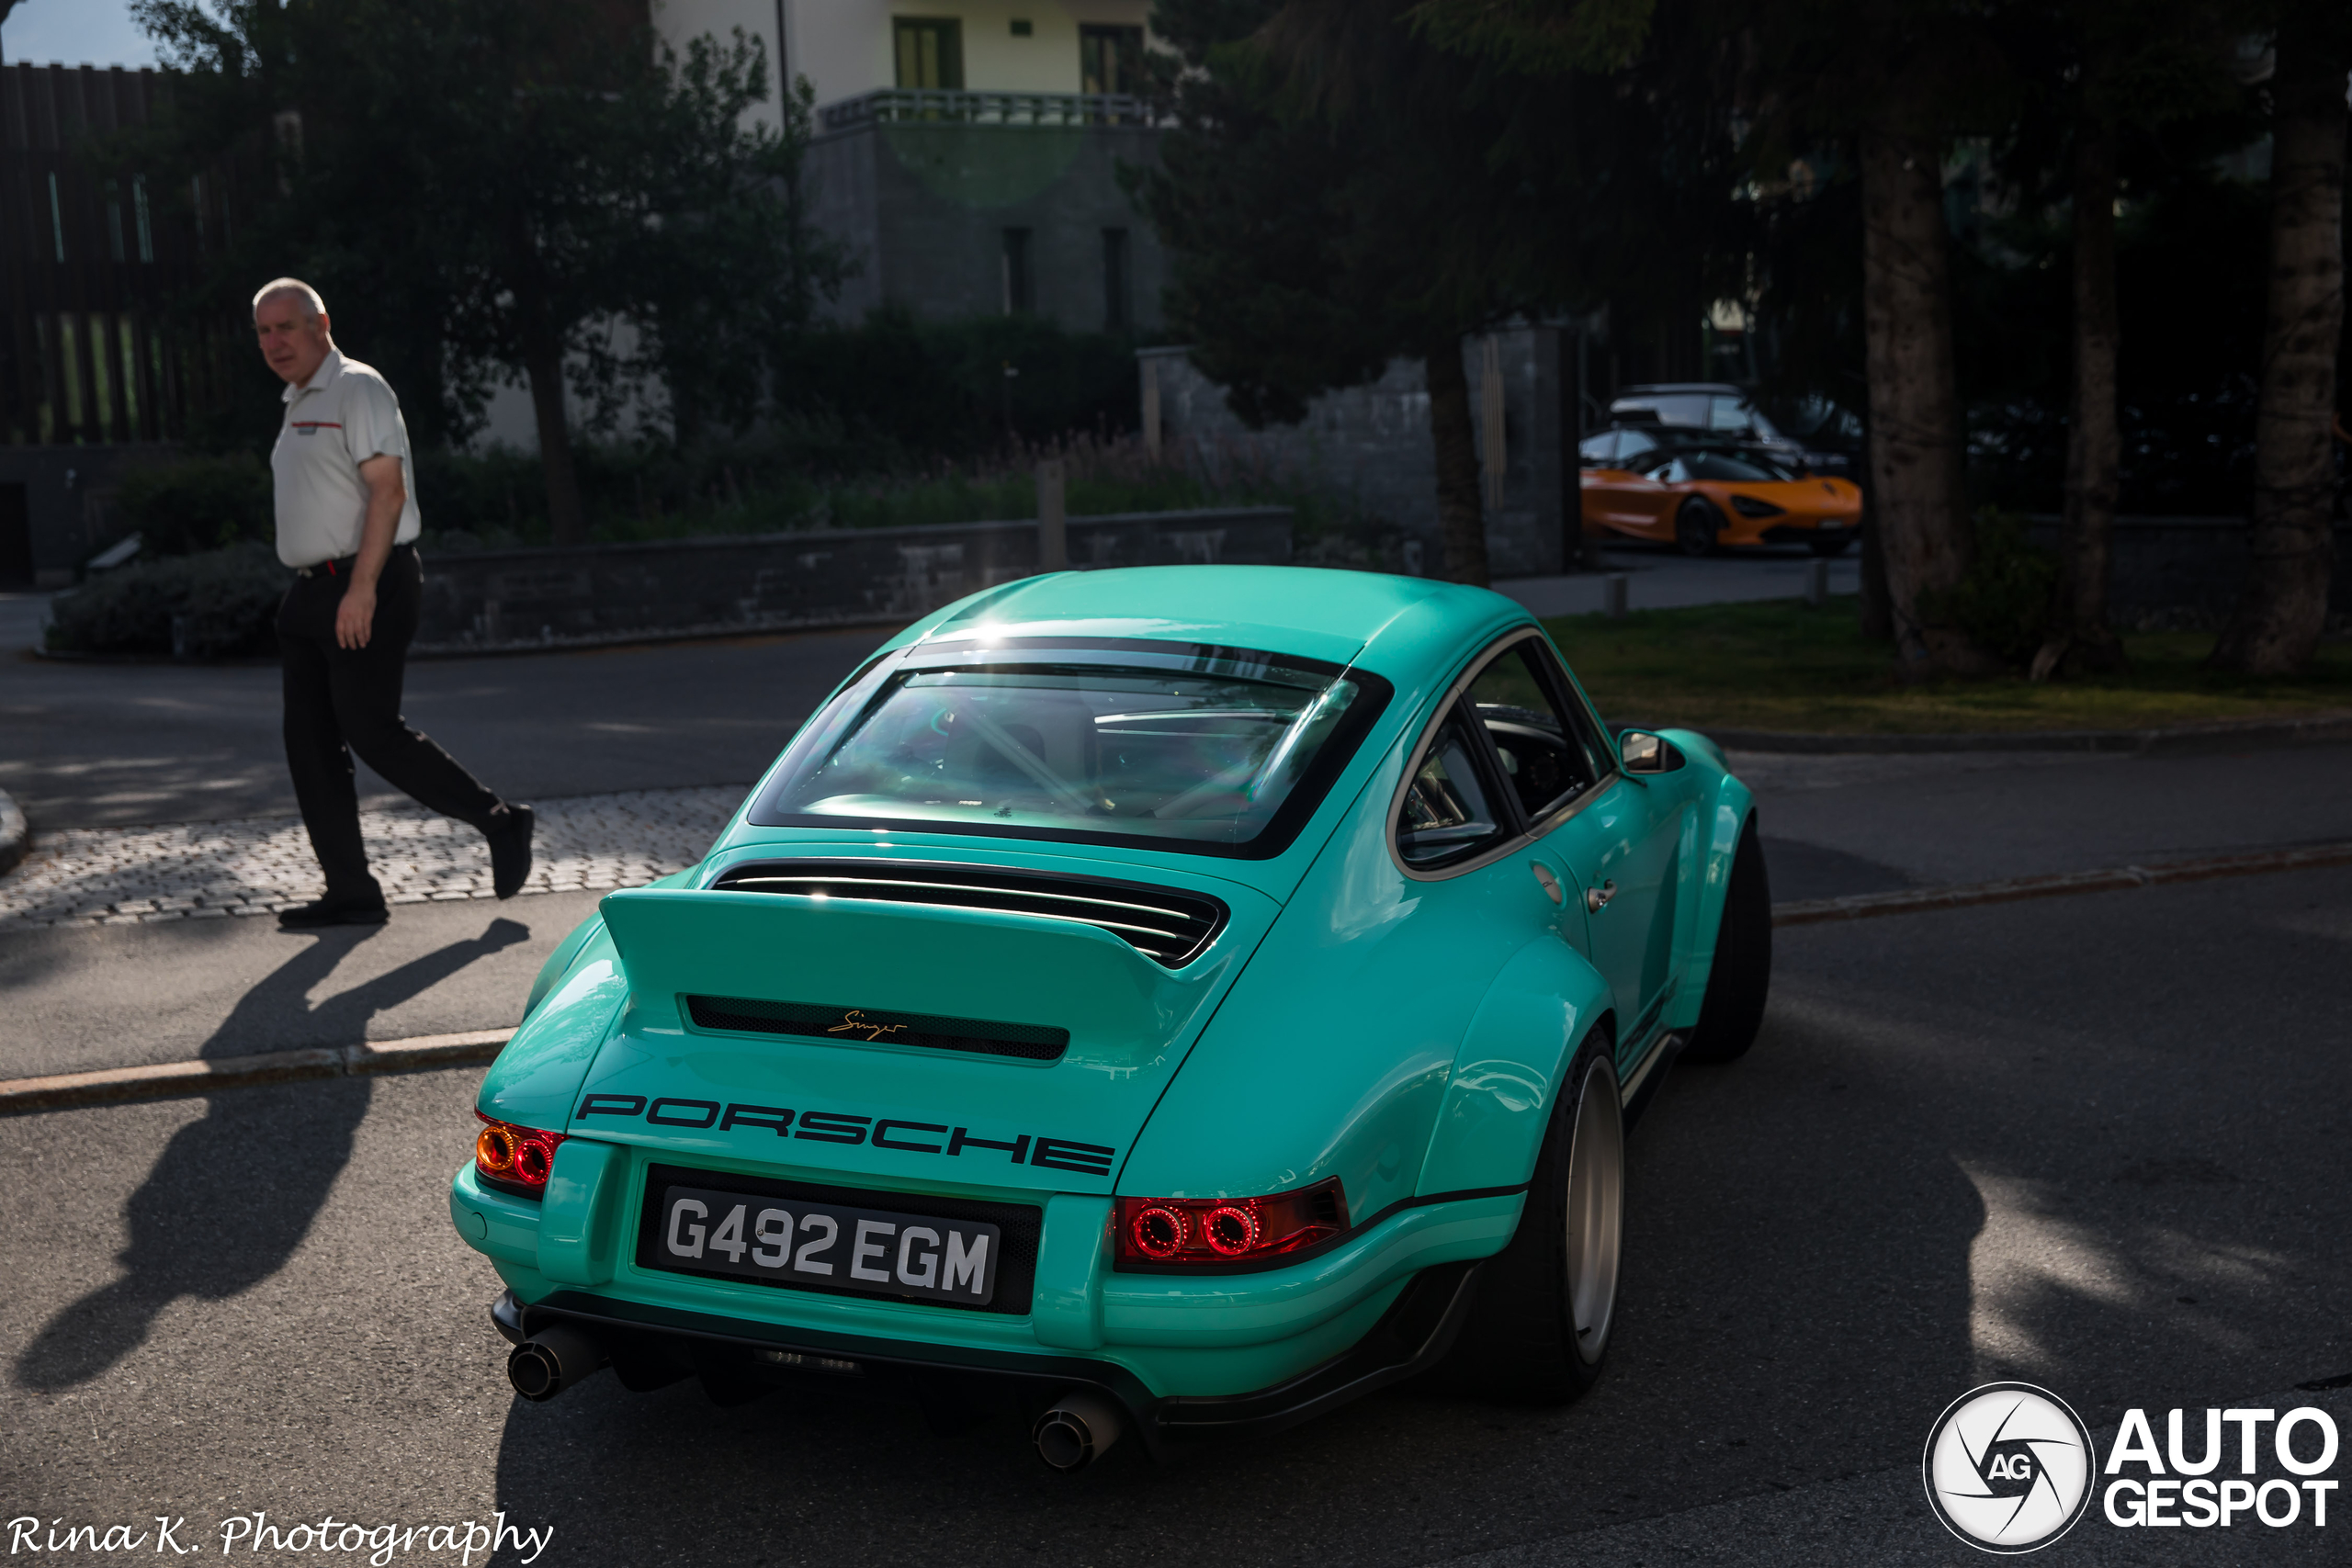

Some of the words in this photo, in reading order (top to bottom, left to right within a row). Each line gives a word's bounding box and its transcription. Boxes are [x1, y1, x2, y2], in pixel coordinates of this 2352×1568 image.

[827, 1010, 908, 1041] Singer
[575, 1093, 1116, 1177] PORSCHE
[667, 1198, 839, 1276] G492
[850, 1219, 989, 1295] EGM
